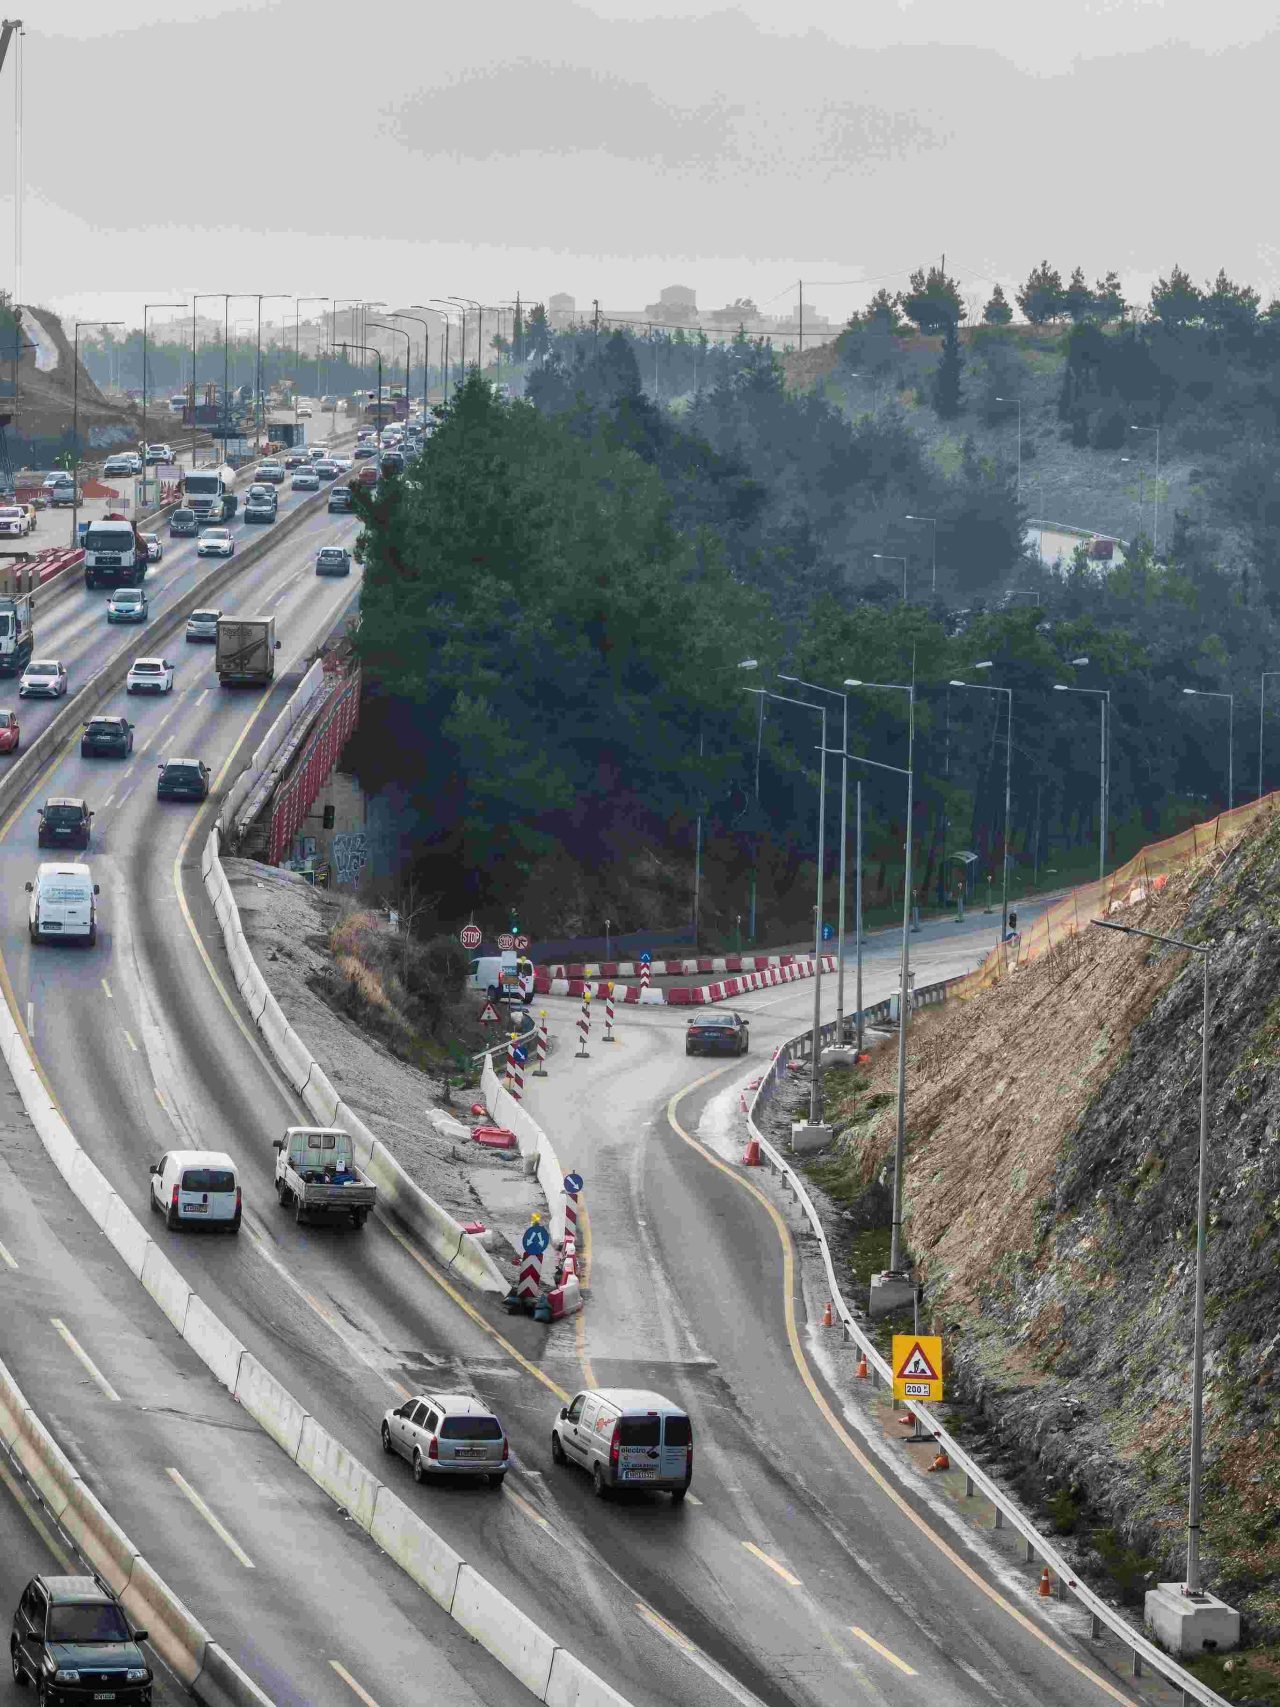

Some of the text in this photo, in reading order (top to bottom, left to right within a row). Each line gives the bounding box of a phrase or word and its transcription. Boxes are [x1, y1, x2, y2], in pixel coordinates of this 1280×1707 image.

[462, 931, 480, 943] STOP
[500, 937, 512, 946] STOP
[907, 1385, 922, 1393] 200
